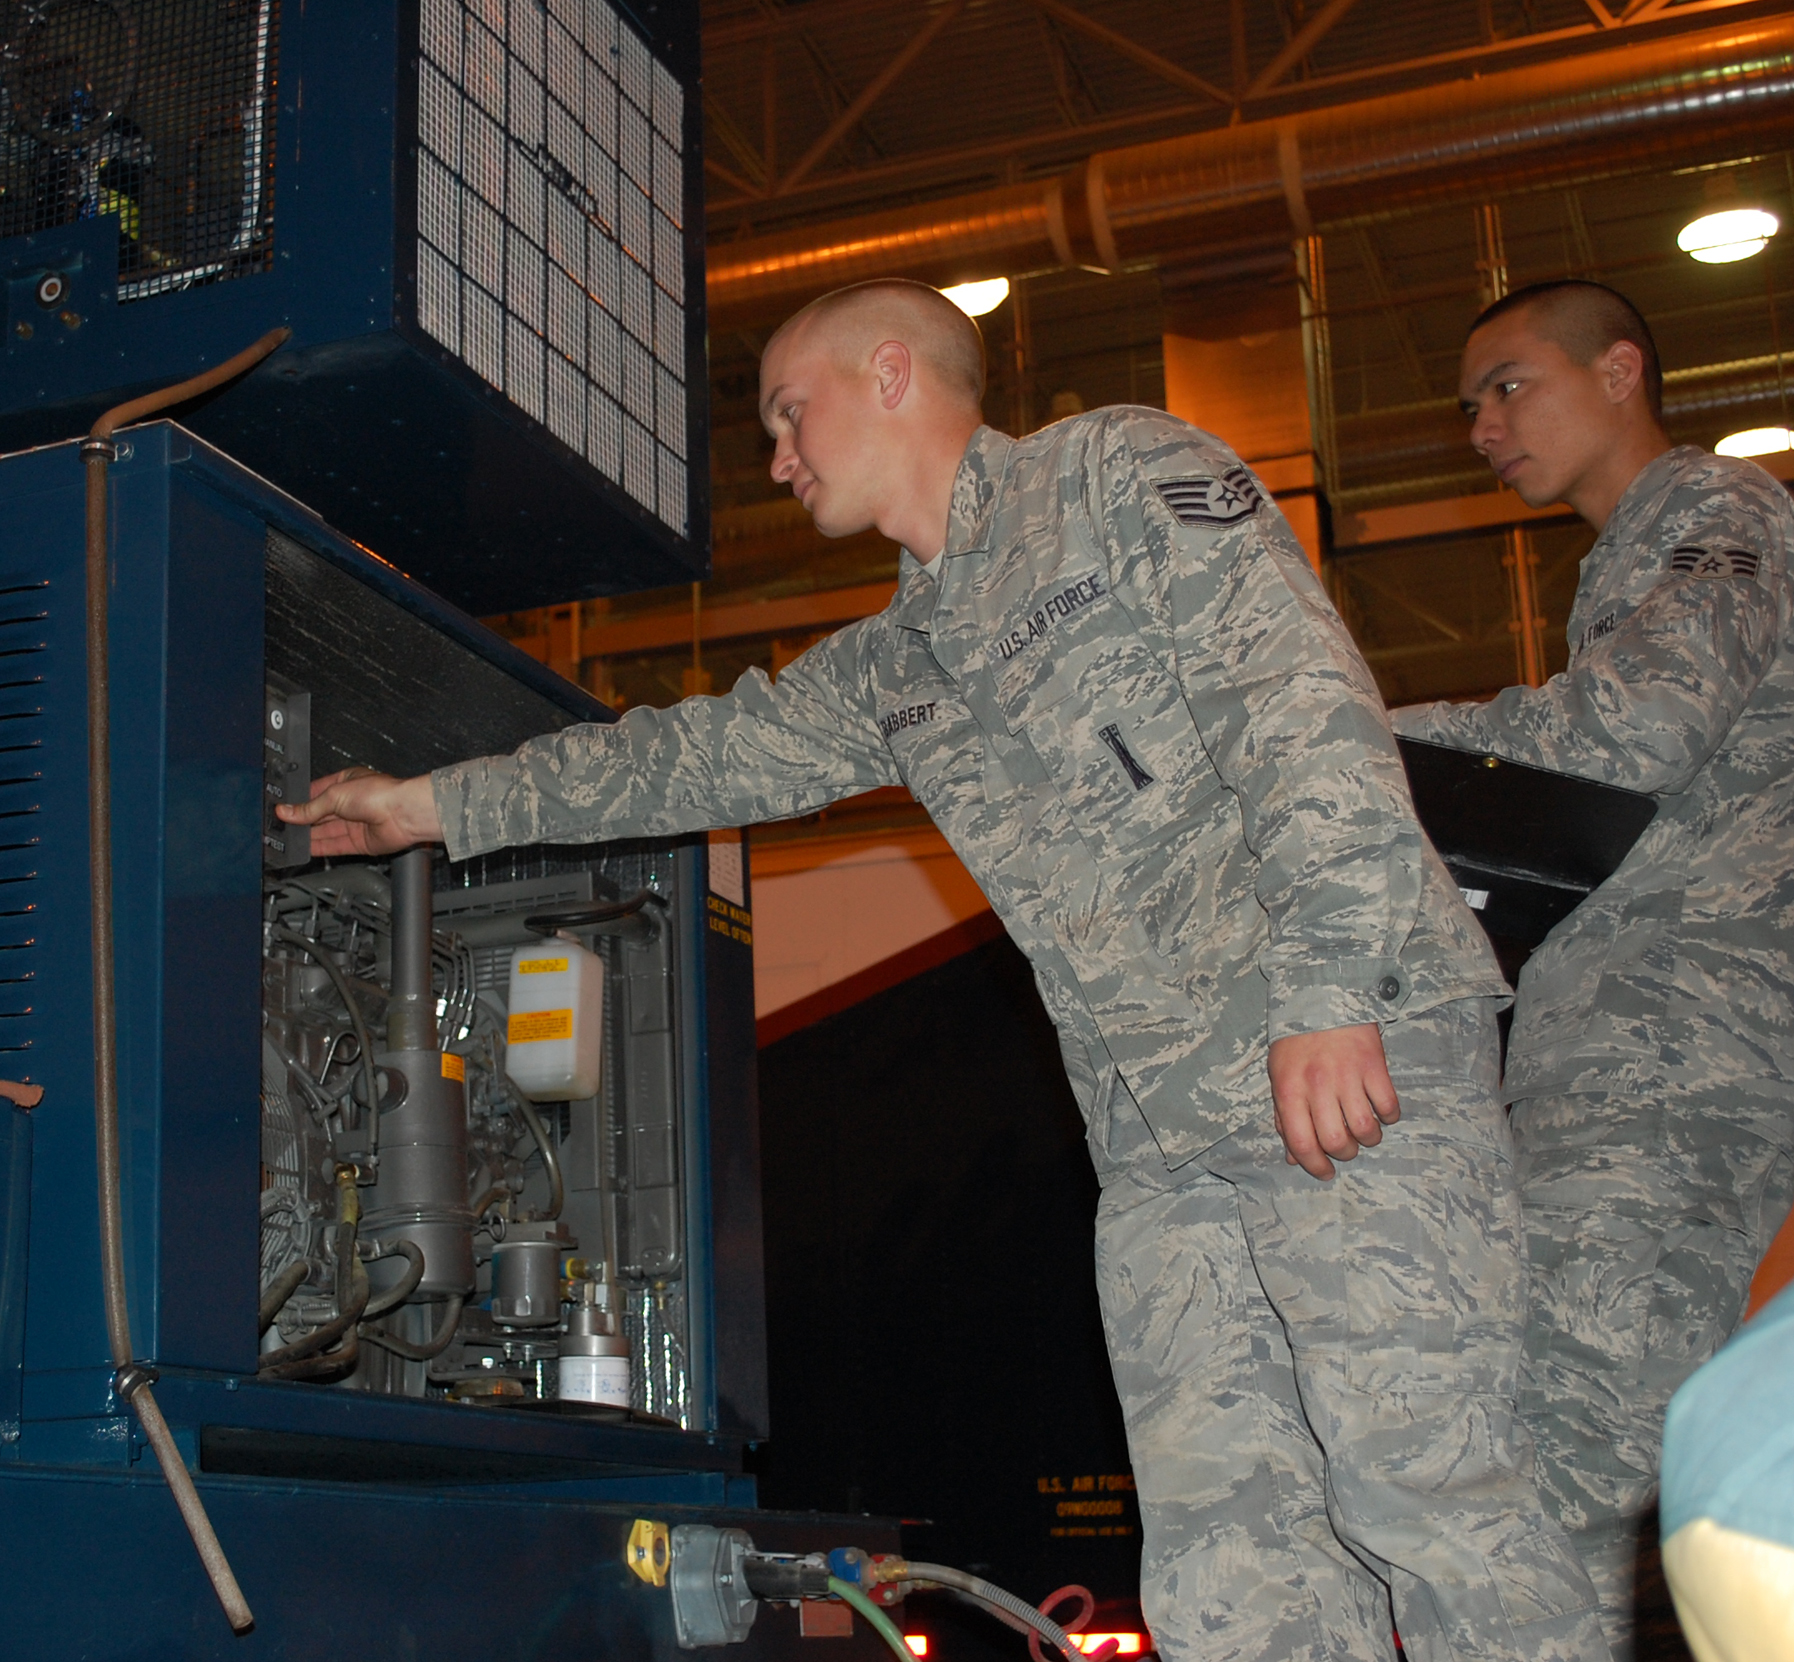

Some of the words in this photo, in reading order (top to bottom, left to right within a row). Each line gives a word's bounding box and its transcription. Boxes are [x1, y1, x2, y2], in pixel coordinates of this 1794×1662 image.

[999, 630, 1027, 660] U.S.
[1026, 616, 1048, 643] AIR
[1044, 573, 1107, 624] FORCE
[1587, 612, 1615, 645] FORCE
[266, 782, 283, 798] AUTO
[707, 895, 728, 916] CHECK
[709, 915, 731, 936] LEVEL
[1037, 1476, 1066, 1493] U.S.
[1071, 1475, 1094, 1491] AIR
[1098, 1474, 1136, 1491] FORC
